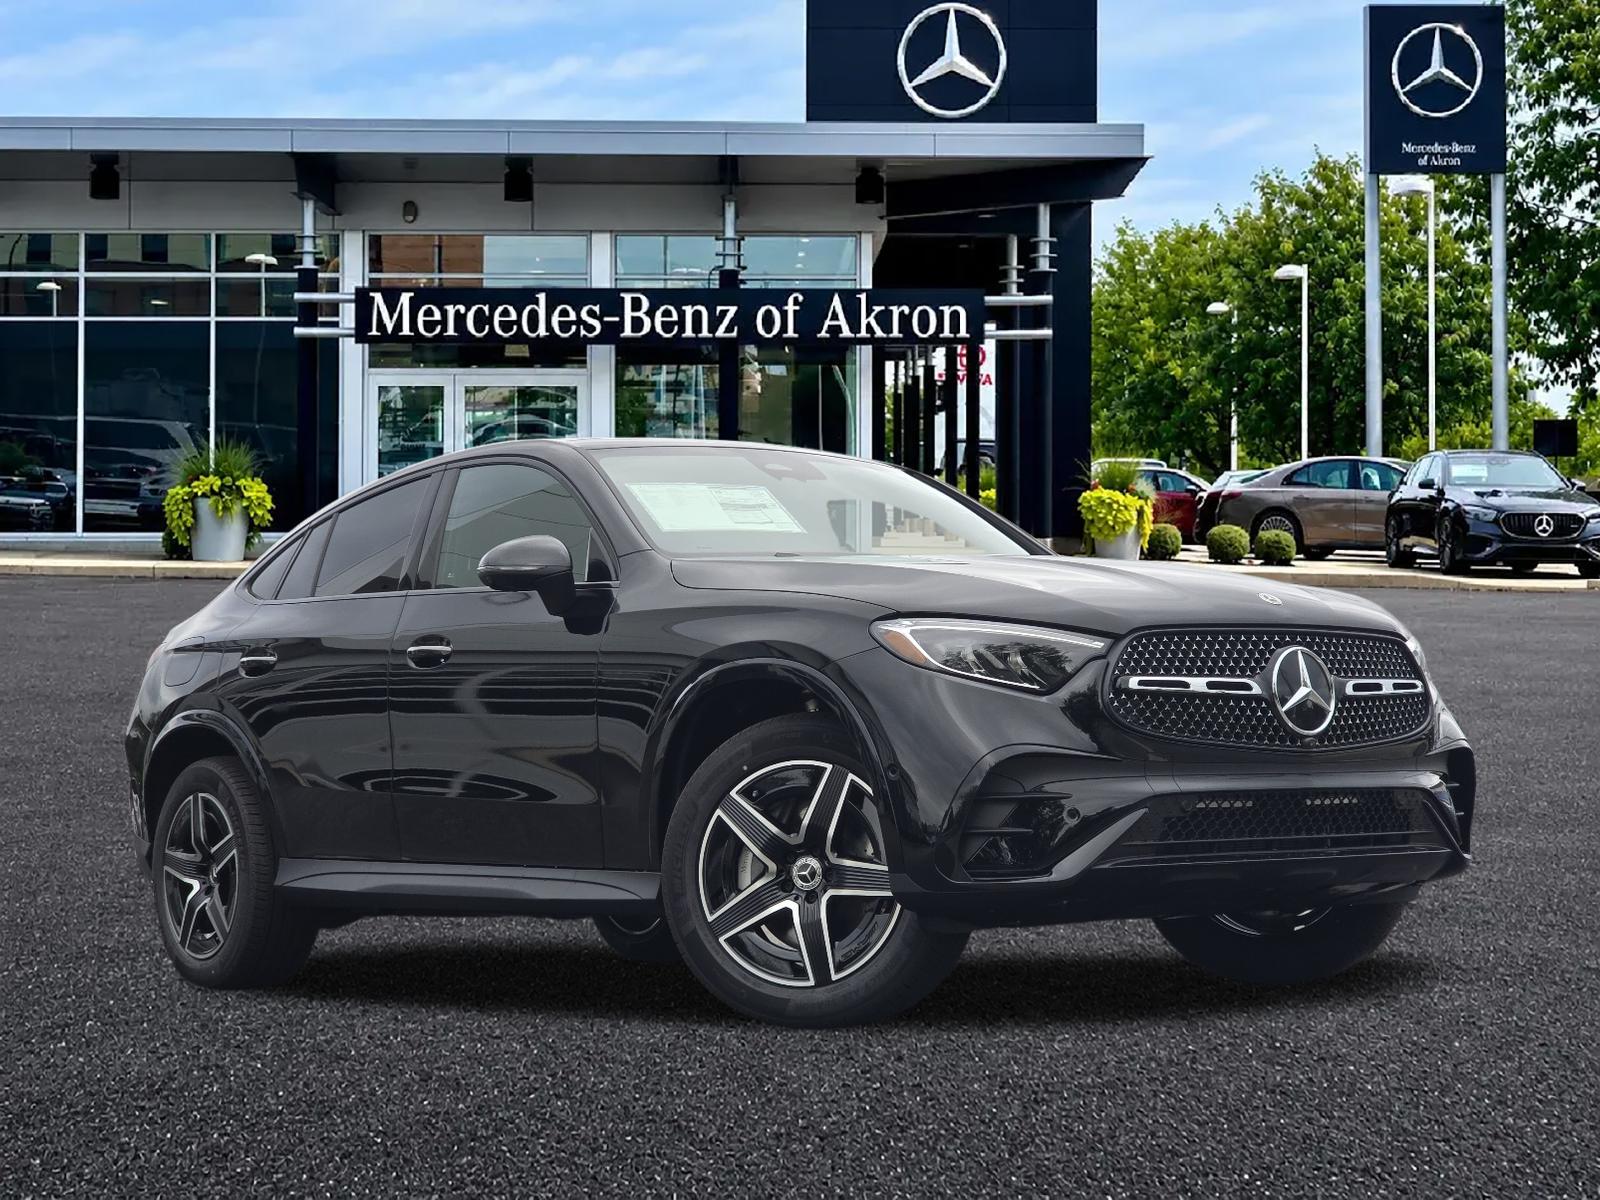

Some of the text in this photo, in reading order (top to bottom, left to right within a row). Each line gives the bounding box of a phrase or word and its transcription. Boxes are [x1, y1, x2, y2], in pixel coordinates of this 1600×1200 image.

[1401, 142, 1476, 153] Mercedes-Benz
[1417, 154, 1461, 166] of Akron
[367, 292, 971, 338] Mercedes-Benz of Akron
